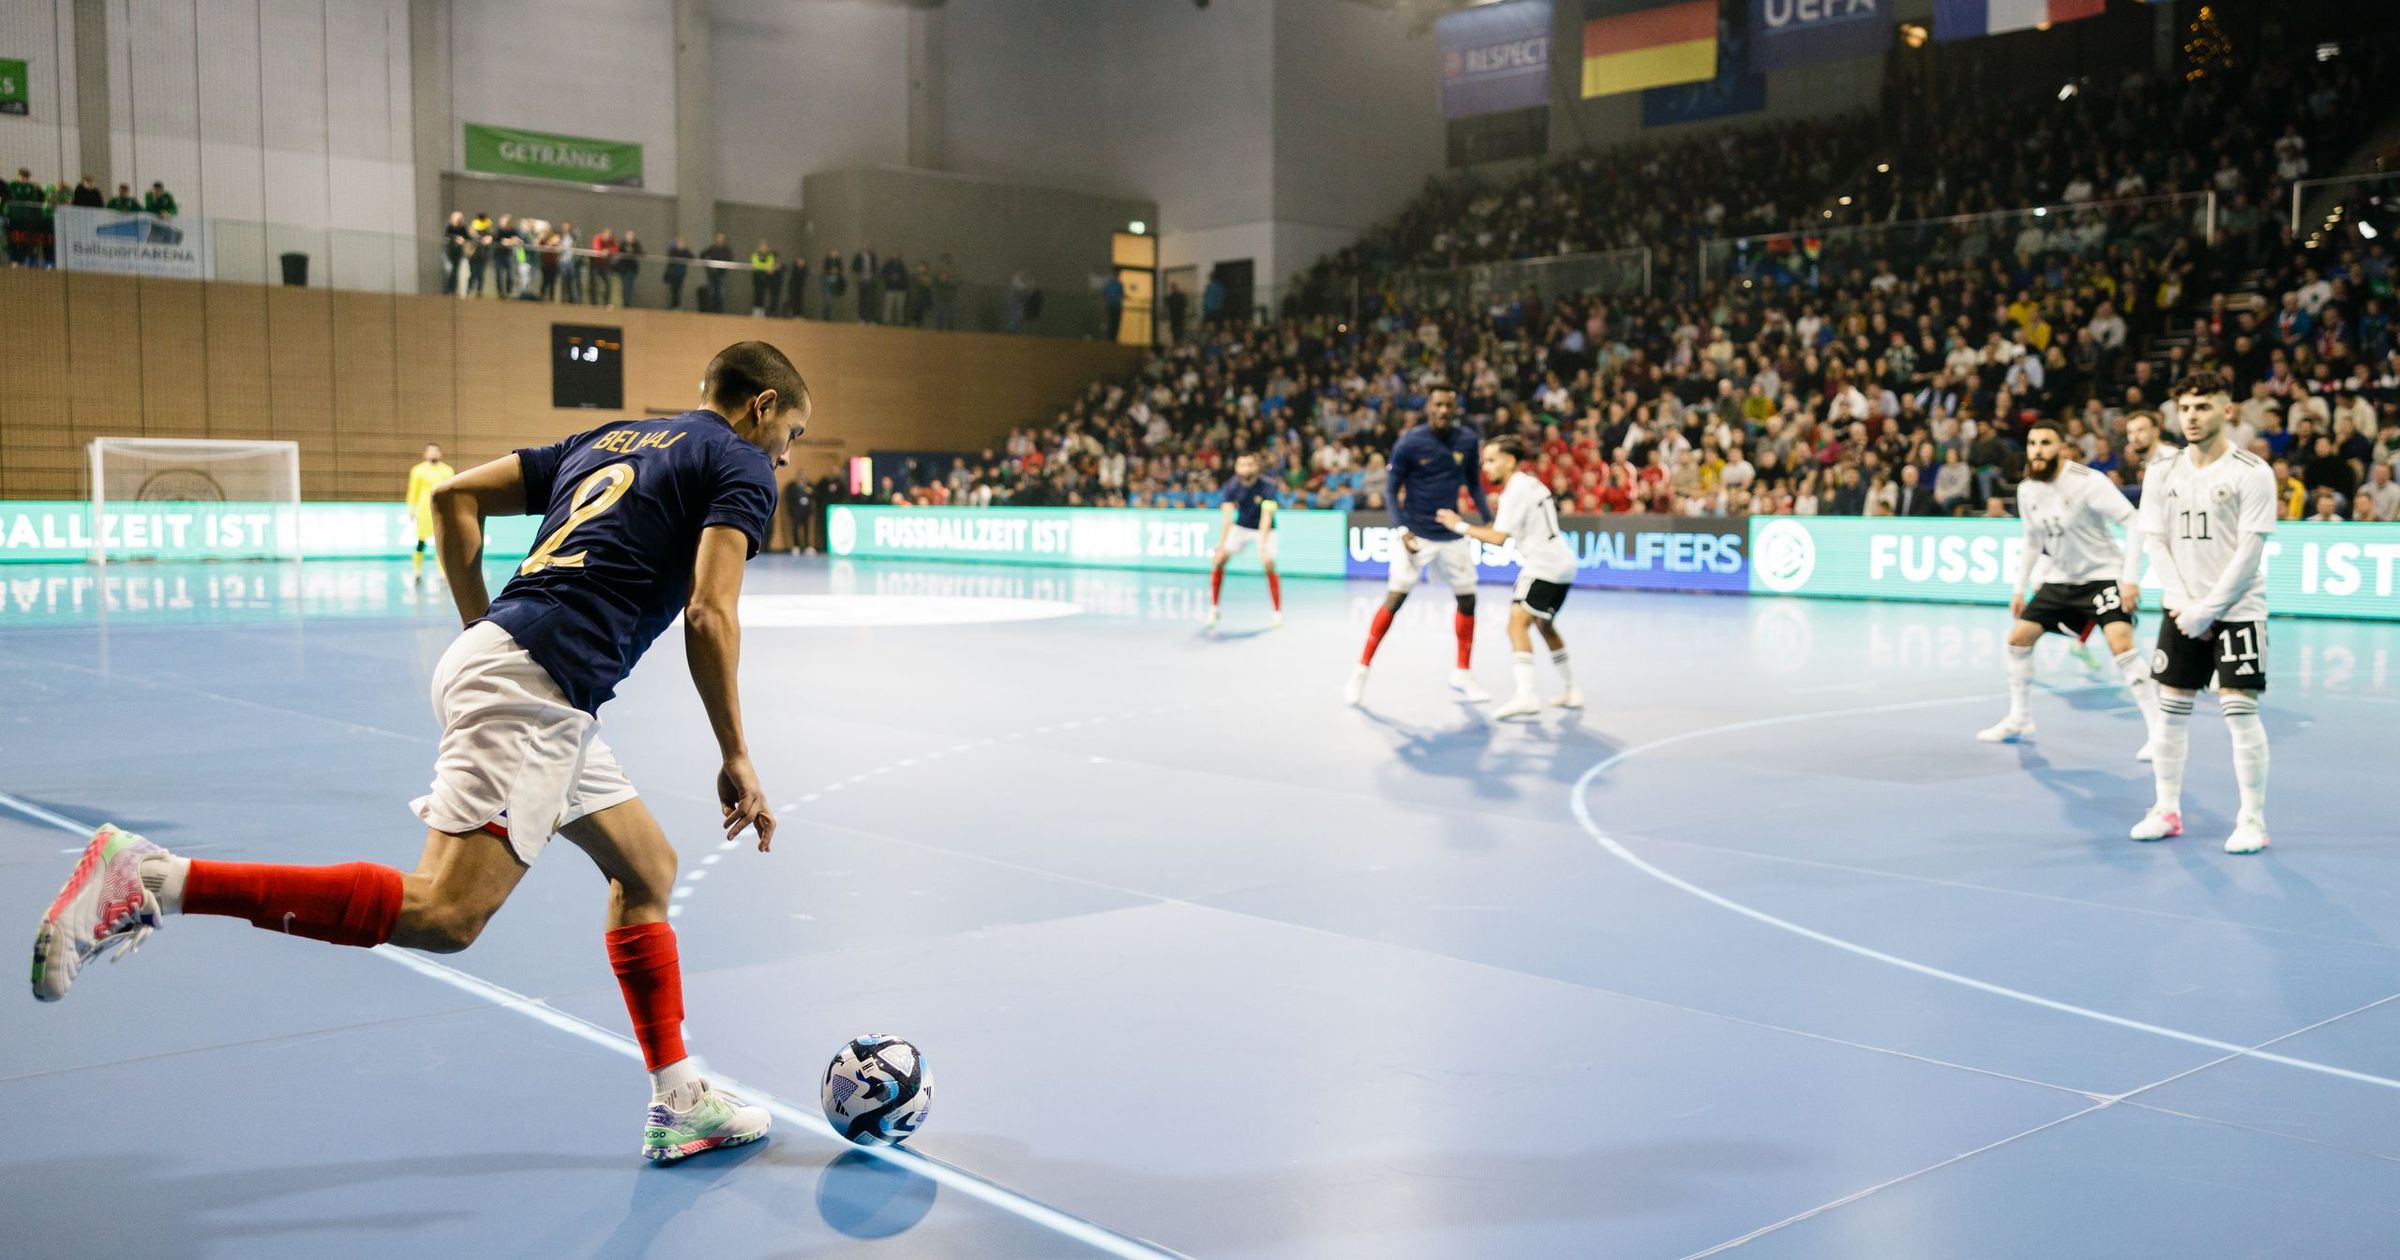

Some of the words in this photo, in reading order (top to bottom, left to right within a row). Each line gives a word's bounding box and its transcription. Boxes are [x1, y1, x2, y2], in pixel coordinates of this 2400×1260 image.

[499, 140, 611, 172] GETRÄNKE
[0, 514, 192, 549] ALLZEIT
[207, 514, 271, 548] IST
[521, 463, 635, 576] 2
[875, 517, 1027, 550] FUSSBALLZEIT
[1033, 520, 1070, 551] IST
[1146, 521, 1215, 557] ZEIT.
[2180, 510, 2212, 540] 11
[2301, 541, 2400, 597] IST
[2093, 586, 2120, 616] 13
[2218, 626, 2258, 663] 11
